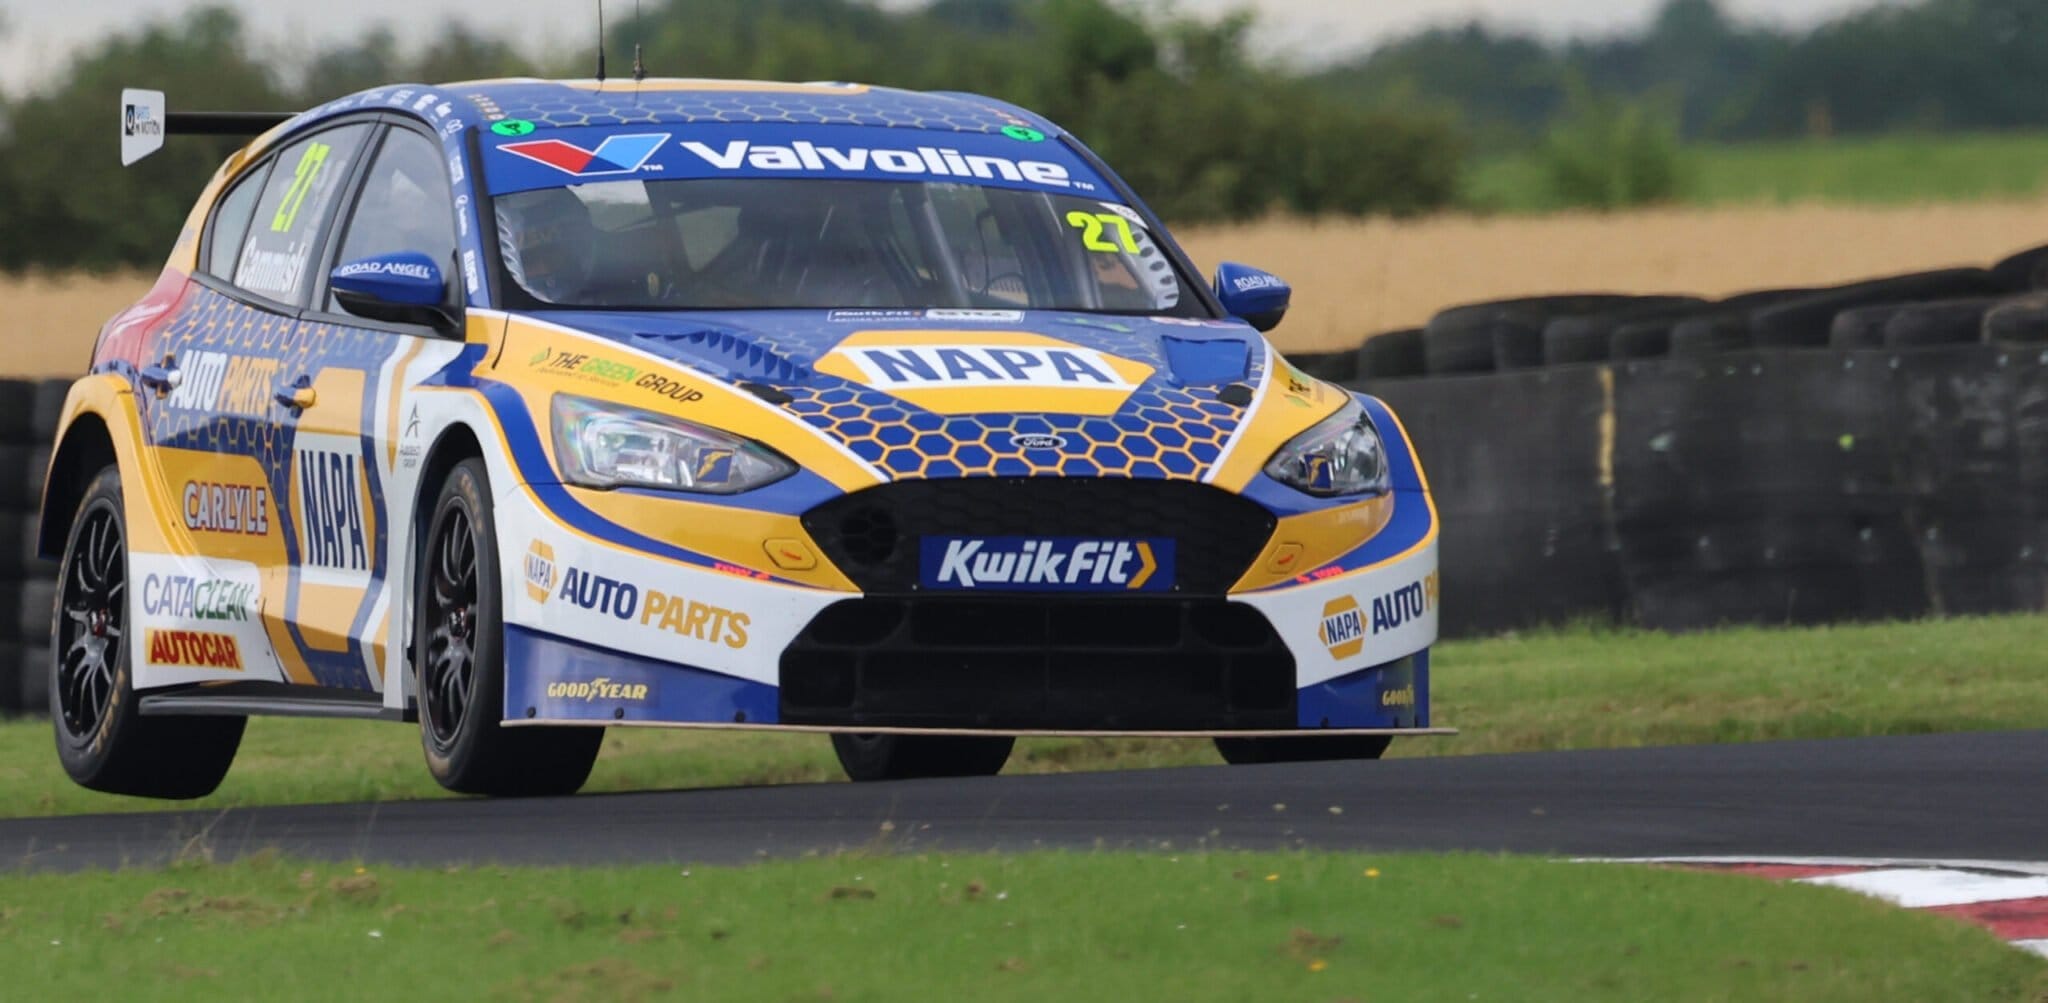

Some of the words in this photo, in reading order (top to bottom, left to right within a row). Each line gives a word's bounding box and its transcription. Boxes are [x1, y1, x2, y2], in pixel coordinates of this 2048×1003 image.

[270, 142, 331, 232] 27
[680, 140, 1070, 187] Valvoline
[1066, 211, 1141, 254] 27
[382, 262, 430, 279] ANGEL
[169, 349, 227, 412] AUTO
[216, 355, 279, 416] PARTS
[550, 352, 588, 369] THE
[580, 357, 639, 383] GREEN
[635, 373, 703, 403] GROUP
[863, 349, 1114, 383] NAPA
[183, 480, 269, 535] CARLYLE
[300, 449, 366, 570] NAPA
[143, 574, 254, 622] CATACLEAN
[526, 555, 551, 588] NAPA
[559, 567, 638, 620] AUTO
[640, 589, 751, 649] PARTS
[1325, 608, 1361, 648] NAPA
[1373, 580, 1423, 635] AUTO
[150, 630, 240, 671] AUTOCAR
[548, 678, 648, 702] GOODYEAR
